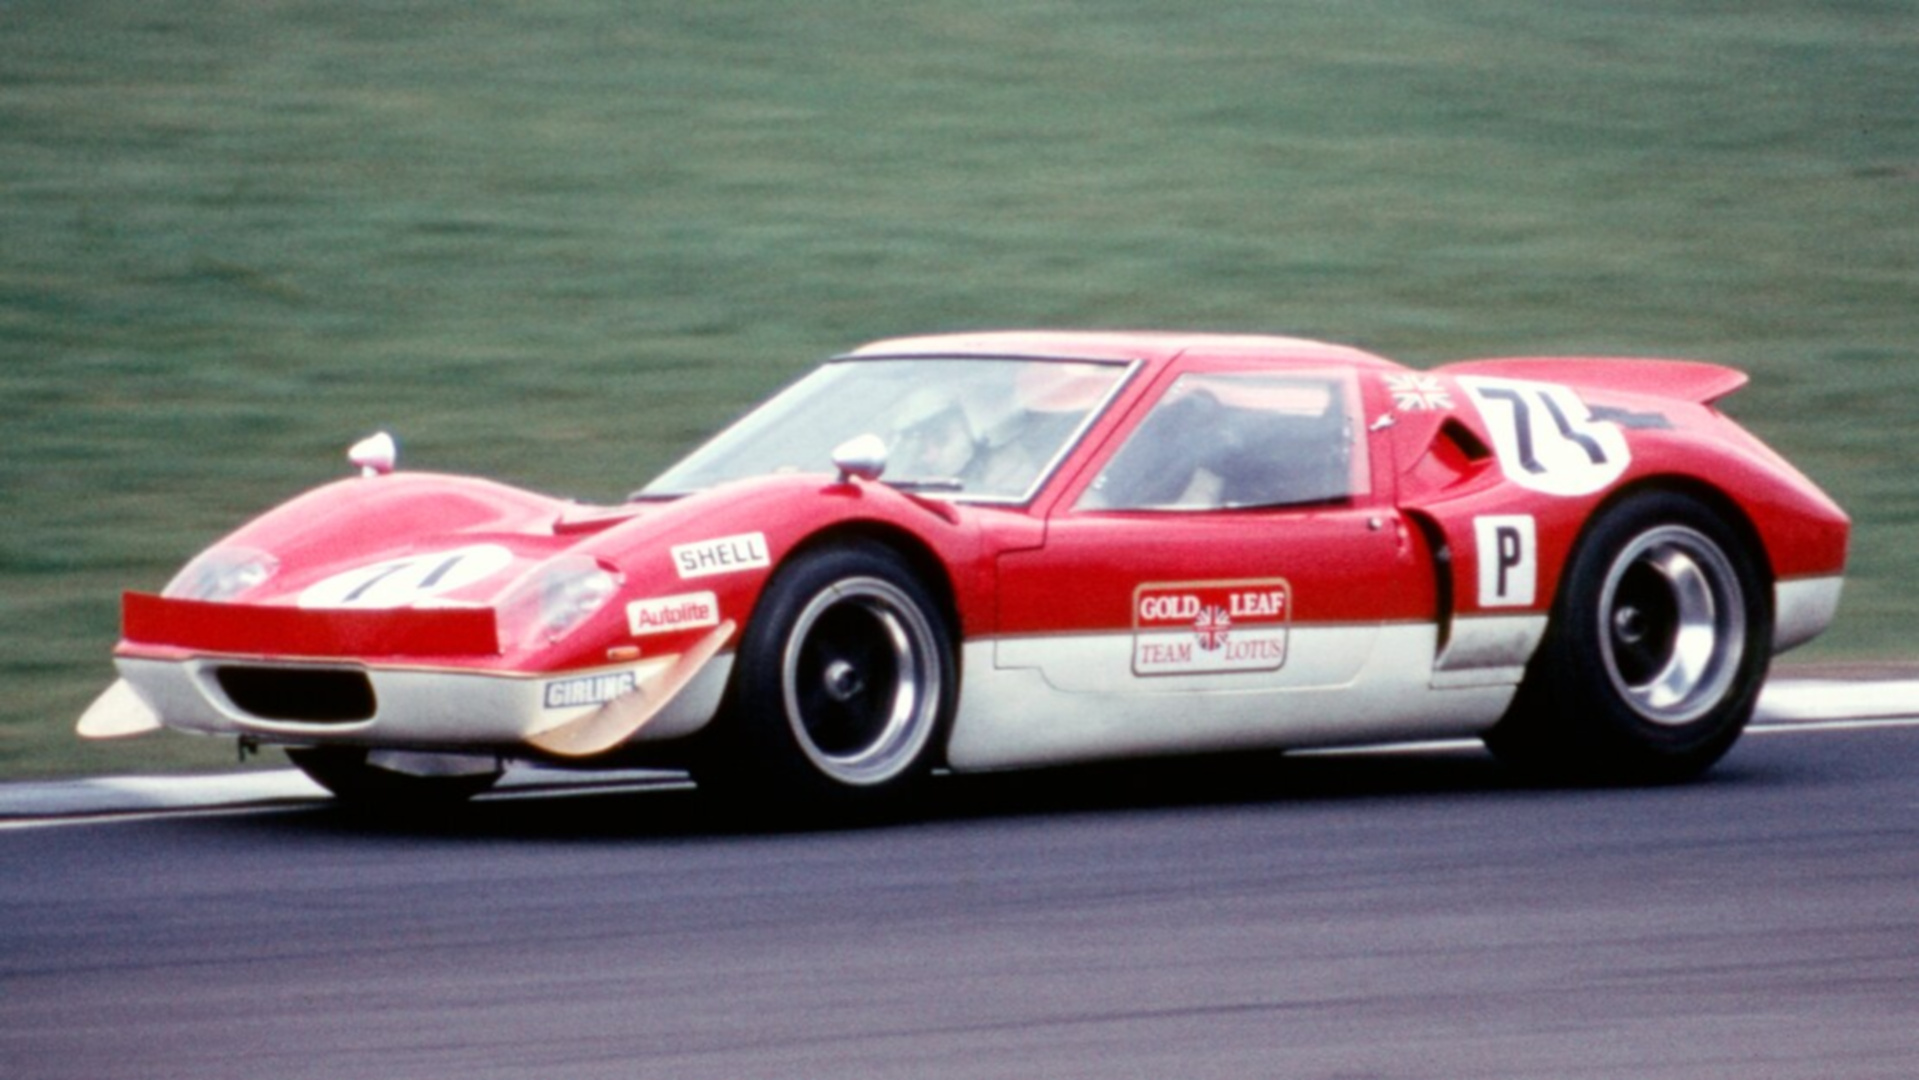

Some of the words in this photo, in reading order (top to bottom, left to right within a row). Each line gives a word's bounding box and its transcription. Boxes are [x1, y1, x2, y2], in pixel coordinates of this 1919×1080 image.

[680, 539, 763, 571] SHELL
[1495, 526, 1521, 597] P
[638, 603, 710, 628] Autolite
[1140, 595, 1200, 620] GOLD
[1229, 591, 1285, 617] LEAF
[1141, 642, 1193, 664] TEAM
[1224, 638, 1284, 661] LOTUS
